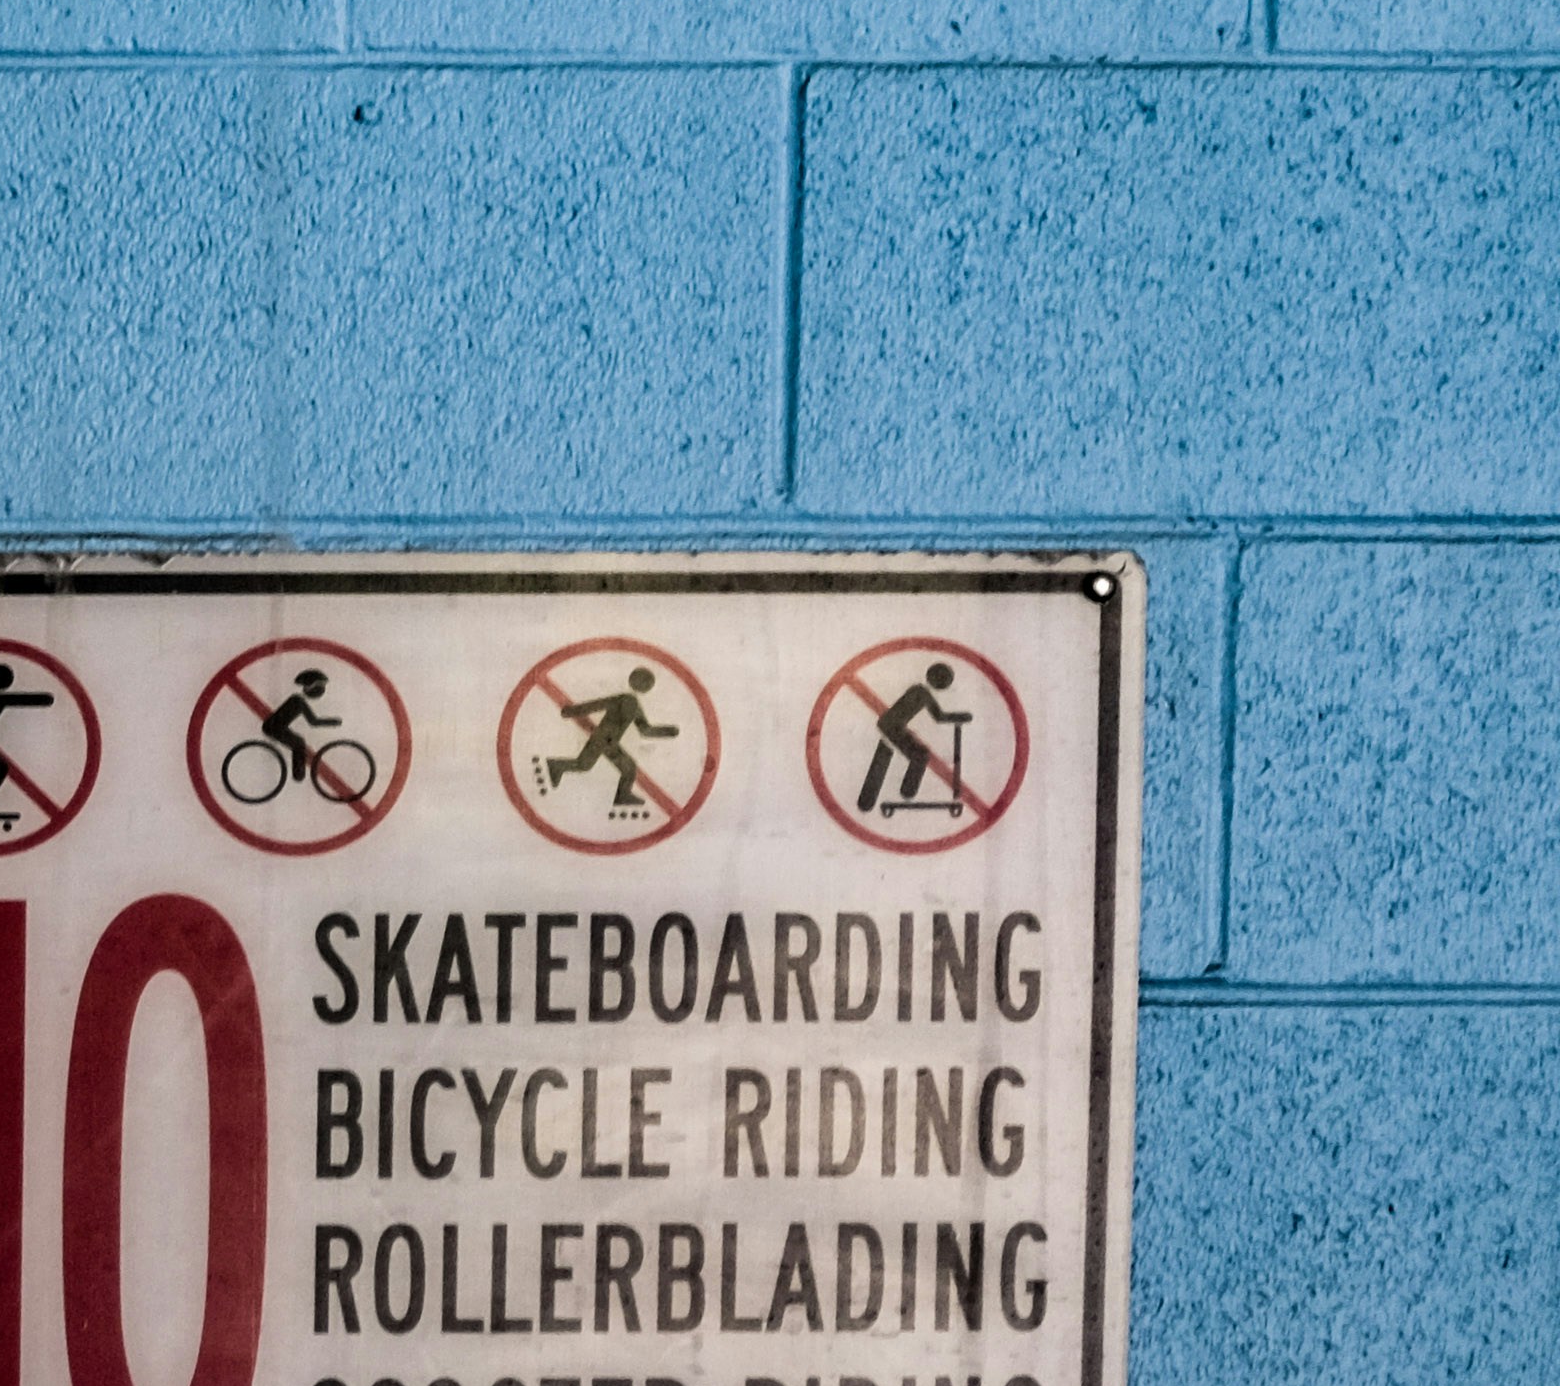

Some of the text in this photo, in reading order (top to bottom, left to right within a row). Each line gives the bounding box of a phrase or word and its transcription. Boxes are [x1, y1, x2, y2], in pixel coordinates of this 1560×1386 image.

[312, 912, 1043, 1026] SKATEBOARDING
[315, 1066, 1027, 1181] BICYCLE RIDING
[313, 1221, 1048, 1336] ROLLERBLADING
